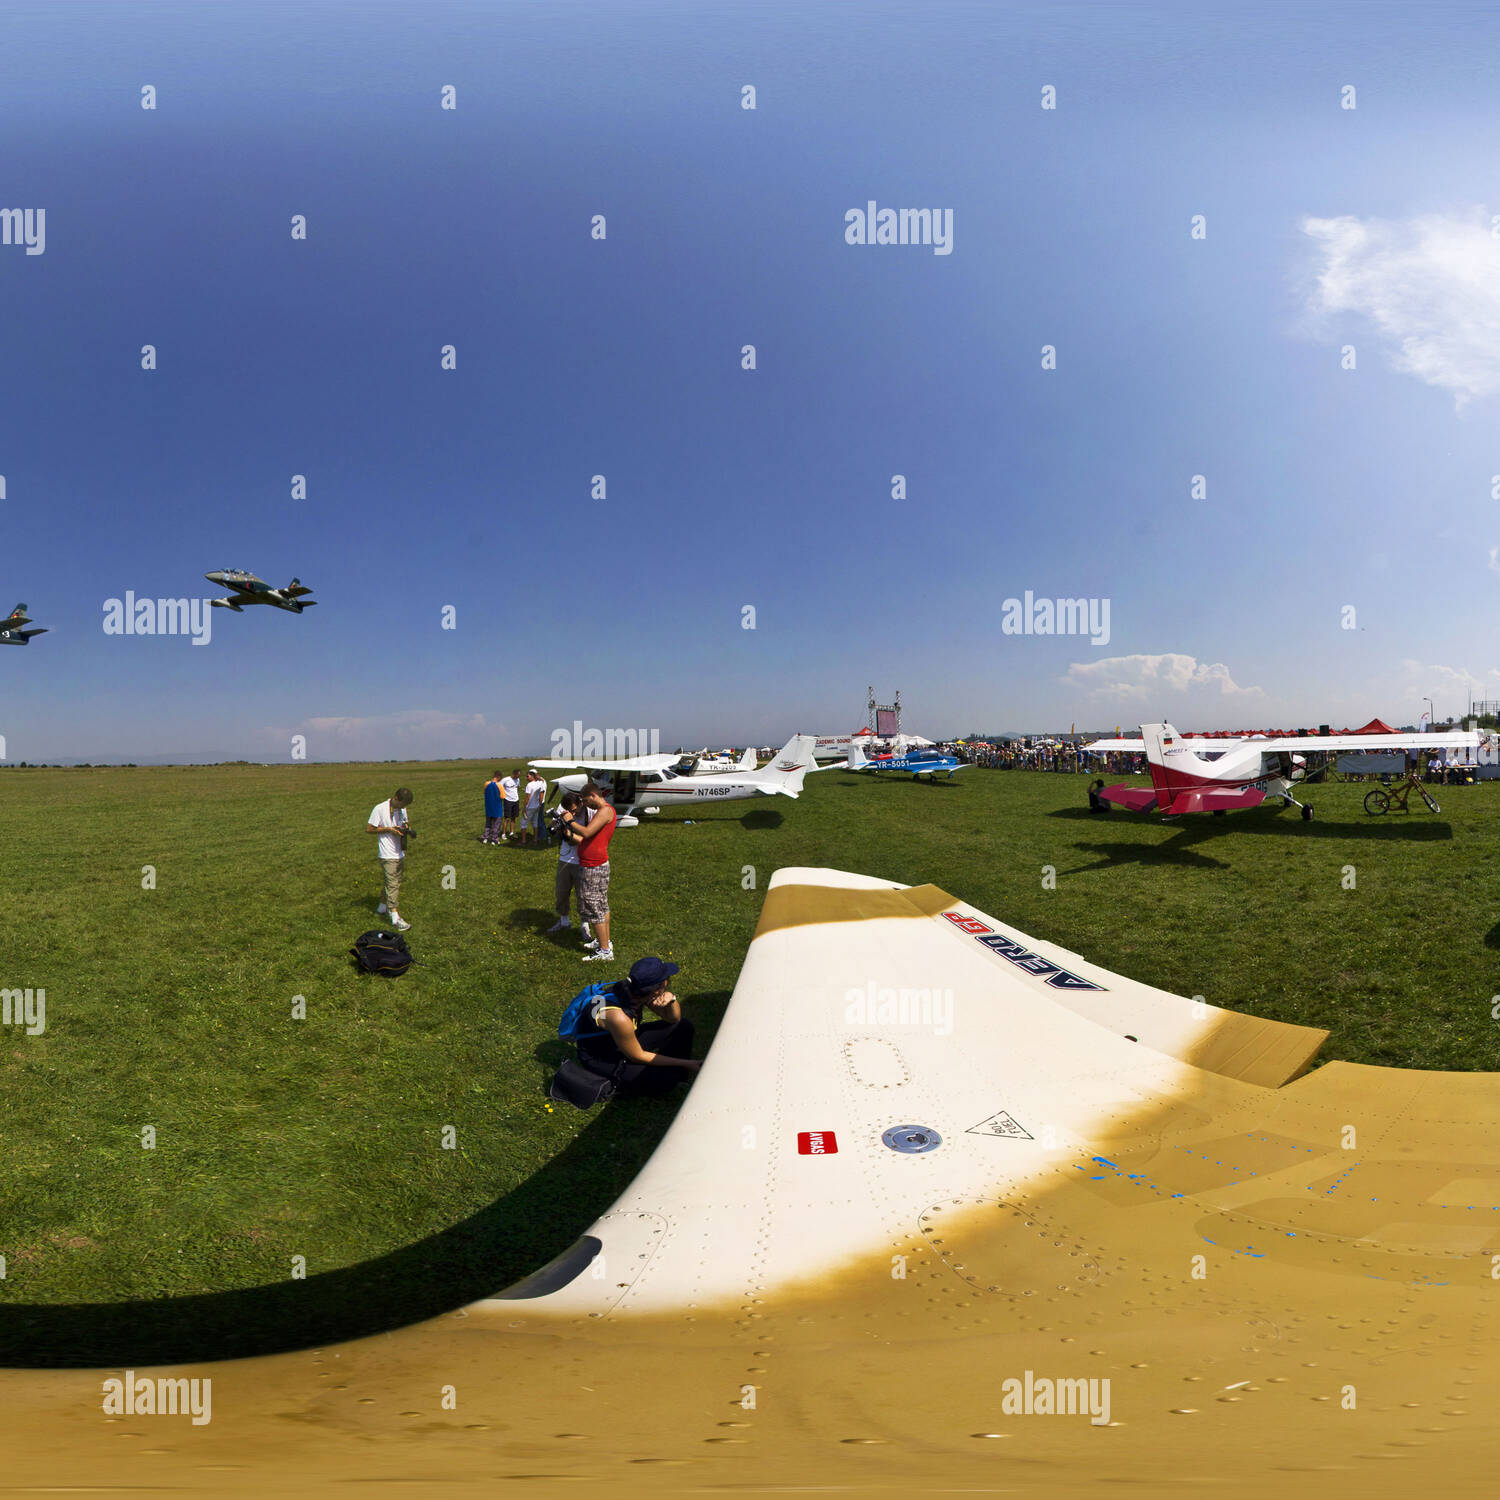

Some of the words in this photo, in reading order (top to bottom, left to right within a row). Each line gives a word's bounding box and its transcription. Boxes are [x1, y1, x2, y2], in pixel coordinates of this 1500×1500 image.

[877, 760, 910, 768] YR-5051
[697, 787, 730, 796] N746SP
[941, 912, 994, 935] GP
[975, 935, 1111, 991] AERO
[809, 1132, 825, 1154] AVGAS
